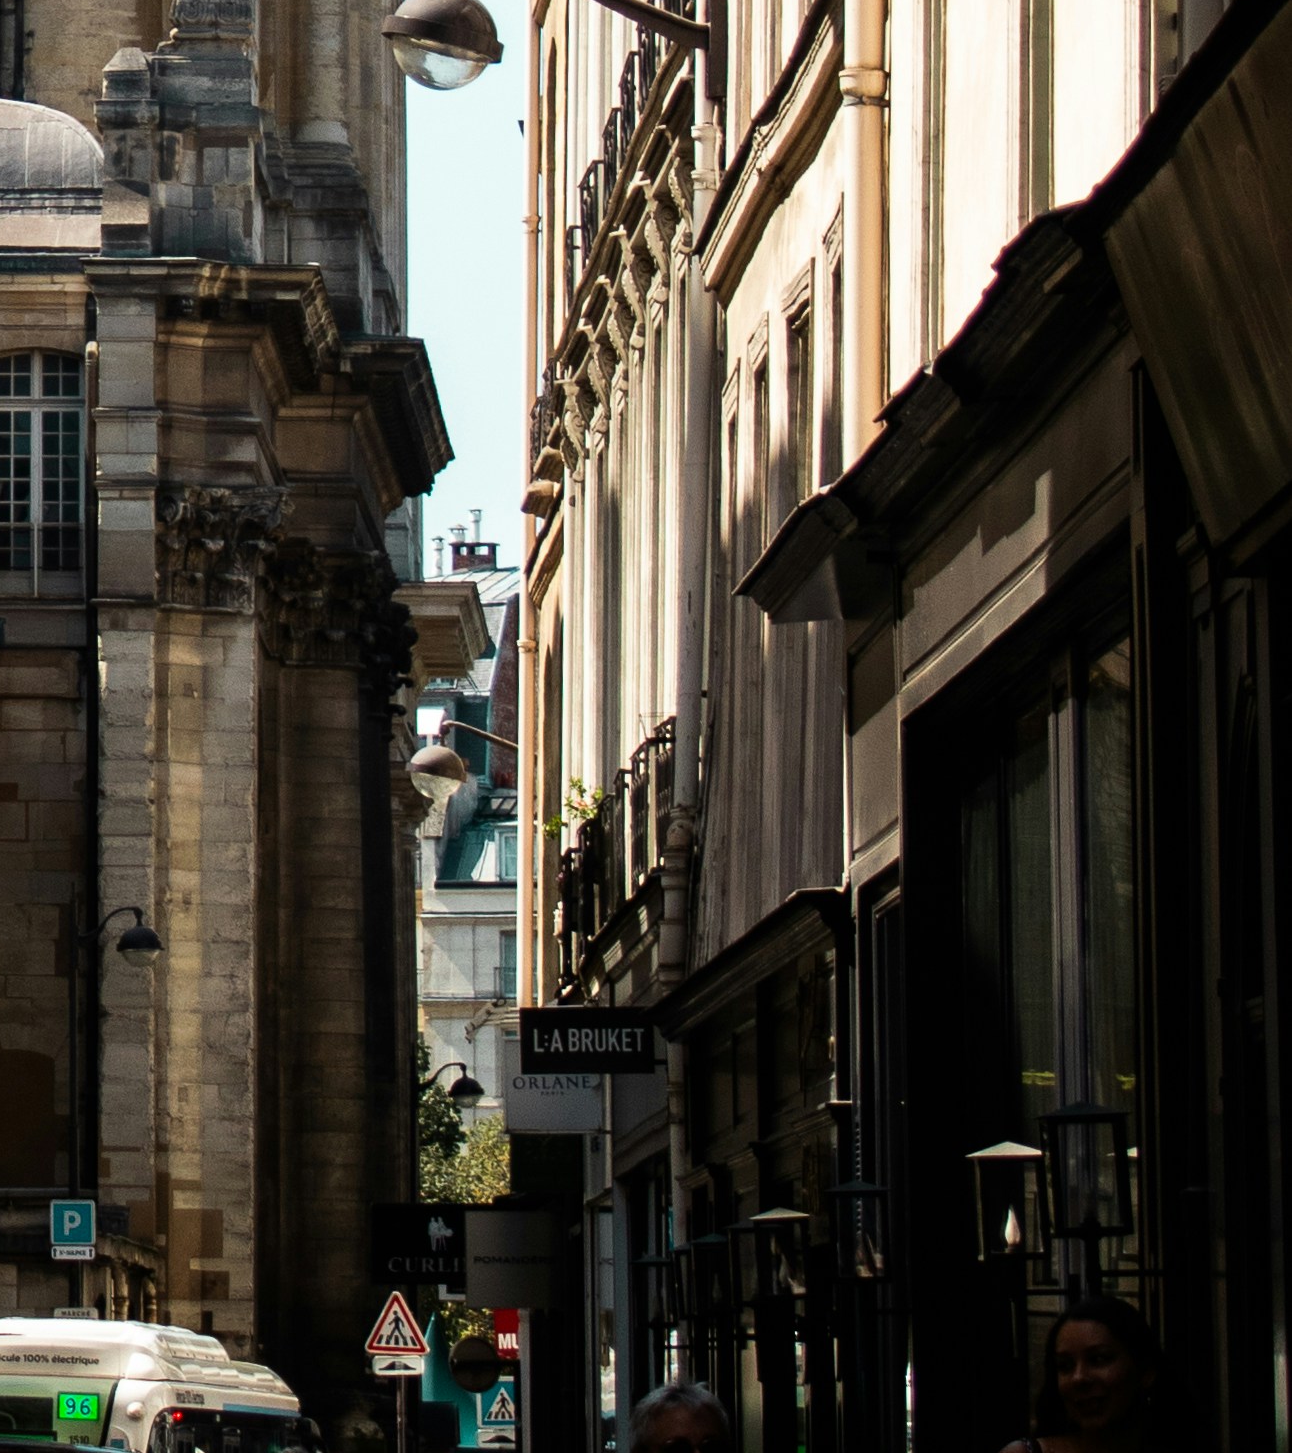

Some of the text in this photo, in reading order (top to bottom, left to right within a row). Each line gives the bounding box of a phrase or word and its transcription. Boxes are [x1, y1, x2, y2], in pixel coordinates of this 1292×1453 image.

[532, 1027, 645, 1053] L:A BRUKET
[512, 1076, 593, 1090] ORLANE
[63, 1210, 81, 1236] P
[387, 1256, 466, 1273] CURLI
[23, 1354, 49, 1364] 100%
[51, 1354, 100, 1366] électrique
[65, 1398, 91, 1416] 96
